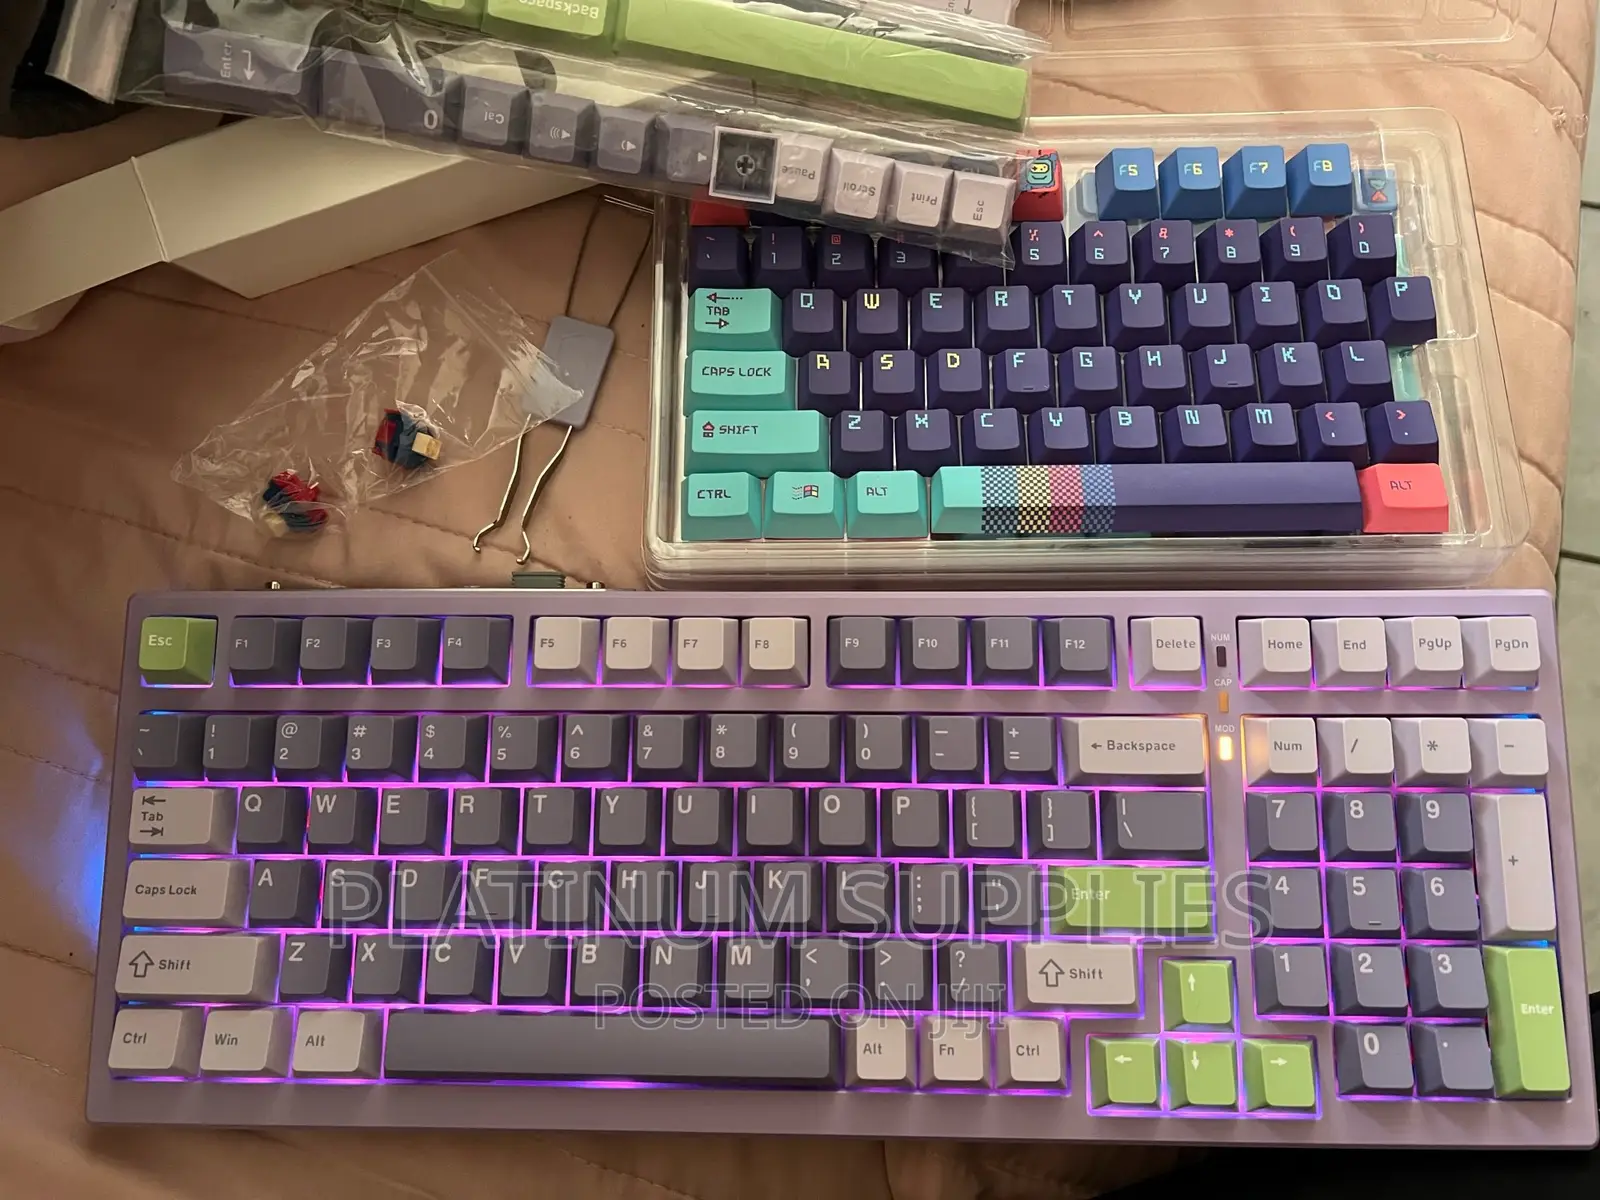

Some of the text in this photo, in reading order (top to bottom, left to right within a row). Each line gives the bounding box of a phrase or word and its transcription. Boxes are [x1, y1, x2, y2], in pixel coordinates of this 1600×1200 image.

[220, 42, 233, 79] Enter
[484, 111, 505, 124] Cal
[782, 166, 816, 180] Pause
[1119, 164, 1138, 177] F5
[1184, 163, 1203, 175] F6
[1249, 162, 1268, 174] F7
[1313, 160, 1332, 173] F8
[843, 182, 876, 197] Scroll
[911, 192, 938, 206] Print
[972, 200, 985, 221] Esc
[896, 251, 906, 263] 3
[1095, 248, 1104, 260] 6
[1160, 247, 1170, 258] 7
[1227, 246, 1237, 258] 8
[1290, 245, 1301, 257] 9
[771, 252, 776, 264] 1
[832, 253, 842, 265] 2
[1194, 288, 1207, 304] U
[1395, 282, 1408, 297] P
[801, 293, 815, 309] Q
[864, 294, 879, 309] W
[929, 293, 943, 309] E
[994, 291, 1008, 307] R
[1061, 290, 1074, 305] T
[1129, 289, 1142, 304] Y
[706, 306, 730, 317] TAB
[1079, 352, 1092, 367] G
[1147, 351, 1161, 366] H
[1214, 349, 1227, 365] J
[1281, 347, 1296, 363] K
[1349, 346, 1364, 361] L
[817, 354, 830, 370] A
[880, 354, 893, 370] S
[947, 353, 960, 368] D
[1013, 353, 1025, 368] F
[702, 367, 772, 377] CAPS LOCK
[848, 415, 862, 430] Z
[915, 413, 928, 428] X
[980, 412, 993, 428] C
[1049, 412, 1063, 427] V
[1118, 411, 1132, 426] B
[1185, 410, 1200, 425] N
[1256, 409, 1273, 424] M
[719, 425, 758, 435] SHIFT
[866, 486, 888, 497] ALT
[1390, 480, 1412, 491] ALT
[697, 489, 731, 499] CTRL
[148, 635, 172, 647] Esc
[235, 639, 248, 648] F1
[306, 638, 320, 648] F2
[376, 638, 391, 648] F3
[447, 638, 462, 647] F4
[541, 638, 555, 648] F5
[612, 638, 627, 648] F6
[683, 639, 698, 649] F7
[755, 639, 769, 649] F8
[845, 638, 859, 648] F9
[918, 639, 938, 649] F10
[991, 639, 1009, 649] F11
[1065, 639, 1085, 649] F12
[1156, 638, 1196, 649] Delete
[1210, 633, 1230, 642] NUM
[1268, 639, 1303, 649] Home
[1419, 638, 1452, 650] PgUp
[1343, 640, 1367, 650] End
[1495, 638, 1529, 651] PgDn
[1214, 678, 1232, 687] CAP
[211, 724, 215, 737] !
[281, 722, 298, 738] @
[353, 725, 367, 738] #
[425, 725, 435, 738] $
[498, 725, 512, 738] %
[642, 725, 653, 737] &
[1215, 725, 1235, 733] MOD
[715, 746, 725, 759] 8
[1107, 740, 1176, 753] Backspace
[1274, 741, 1302, 751] Num
[208, 748, 215, 759] 1
[279, 748, 289, 760] 2
[351, 748, 361, 760] 3
[424, 748, 434, 760] 4
[497, 748, 507, 760] 5
[570, 747, 580, 759] 6
[642, 747, 653, 759] 7
[788, 747, 798, 760] 9
[861, 748, 871, 760] 0
[244, 795, 262, 812] Q
[316, 795, 337, 813] W
[386, 795, 401, 814] E
[459, 795, 475, 814] R
[533, 795, 547, 813] T
[606, 795, 620, 814] Y
[677, 795, 692, 814] U
[751, 795, 756, 814] I
[823, 795, 840, 814] O
[897, 797, 910, 815] P
[1272, 801, 1285, 818] 7
[1350, 801, 1364, 819] 8
[1425, 801, 1440, 819] 9
[141, 811, 164, 822] Tab
[258, 868, 274, 886] A
[331, 868, 345, 887] S
[402, 869, 418, 887] D
[475, 869, 489, 887] F
[548, 870, 565, 889] G
[622, 870, 637, 889] H
[695, 871, 707, 890] J
[768, 870, 783, 889] K
[135, 884, 197, 896] Caps Lock
[1275, 876, 1290, 895] 4
[1352, 877, 1366, 896] 5
[1430, 877, 1445, 896] 6
[1071, 888, 1111, 901] Enter
[289, 942, 306, 962] Z
[361, 942, 377, 962] X
[434, 943, 451, 963] C
[509, 945, 524, 964] V
[581, 944, 597, 964] B
[655, 945, 672, 965] N
[731, 945, 752, 966] M
[158, 959, 191, 971] Shift
[955, 951, 966, 968] ?
[1280, 953, 1290, 973] 1
[1358, 952, 1374, 974] 2
[1437, 953, 1452, 974] 3
[1069, 968, 1103, 980] Shift
[1521, 1003, 1554, 1015] Enter
[122, 1032, 147, 1045] Ctrl
[214, 1034, 238, 1046] Win
[305, 1034, 325, 1047] Alt
[1363, 1032, 1380, 1056] 0
[863, 1043, 882, 1056] Alt
[938, 1044, 955, 1056] Fn
[1016, 1044, 1040, 1057] Ctrl
